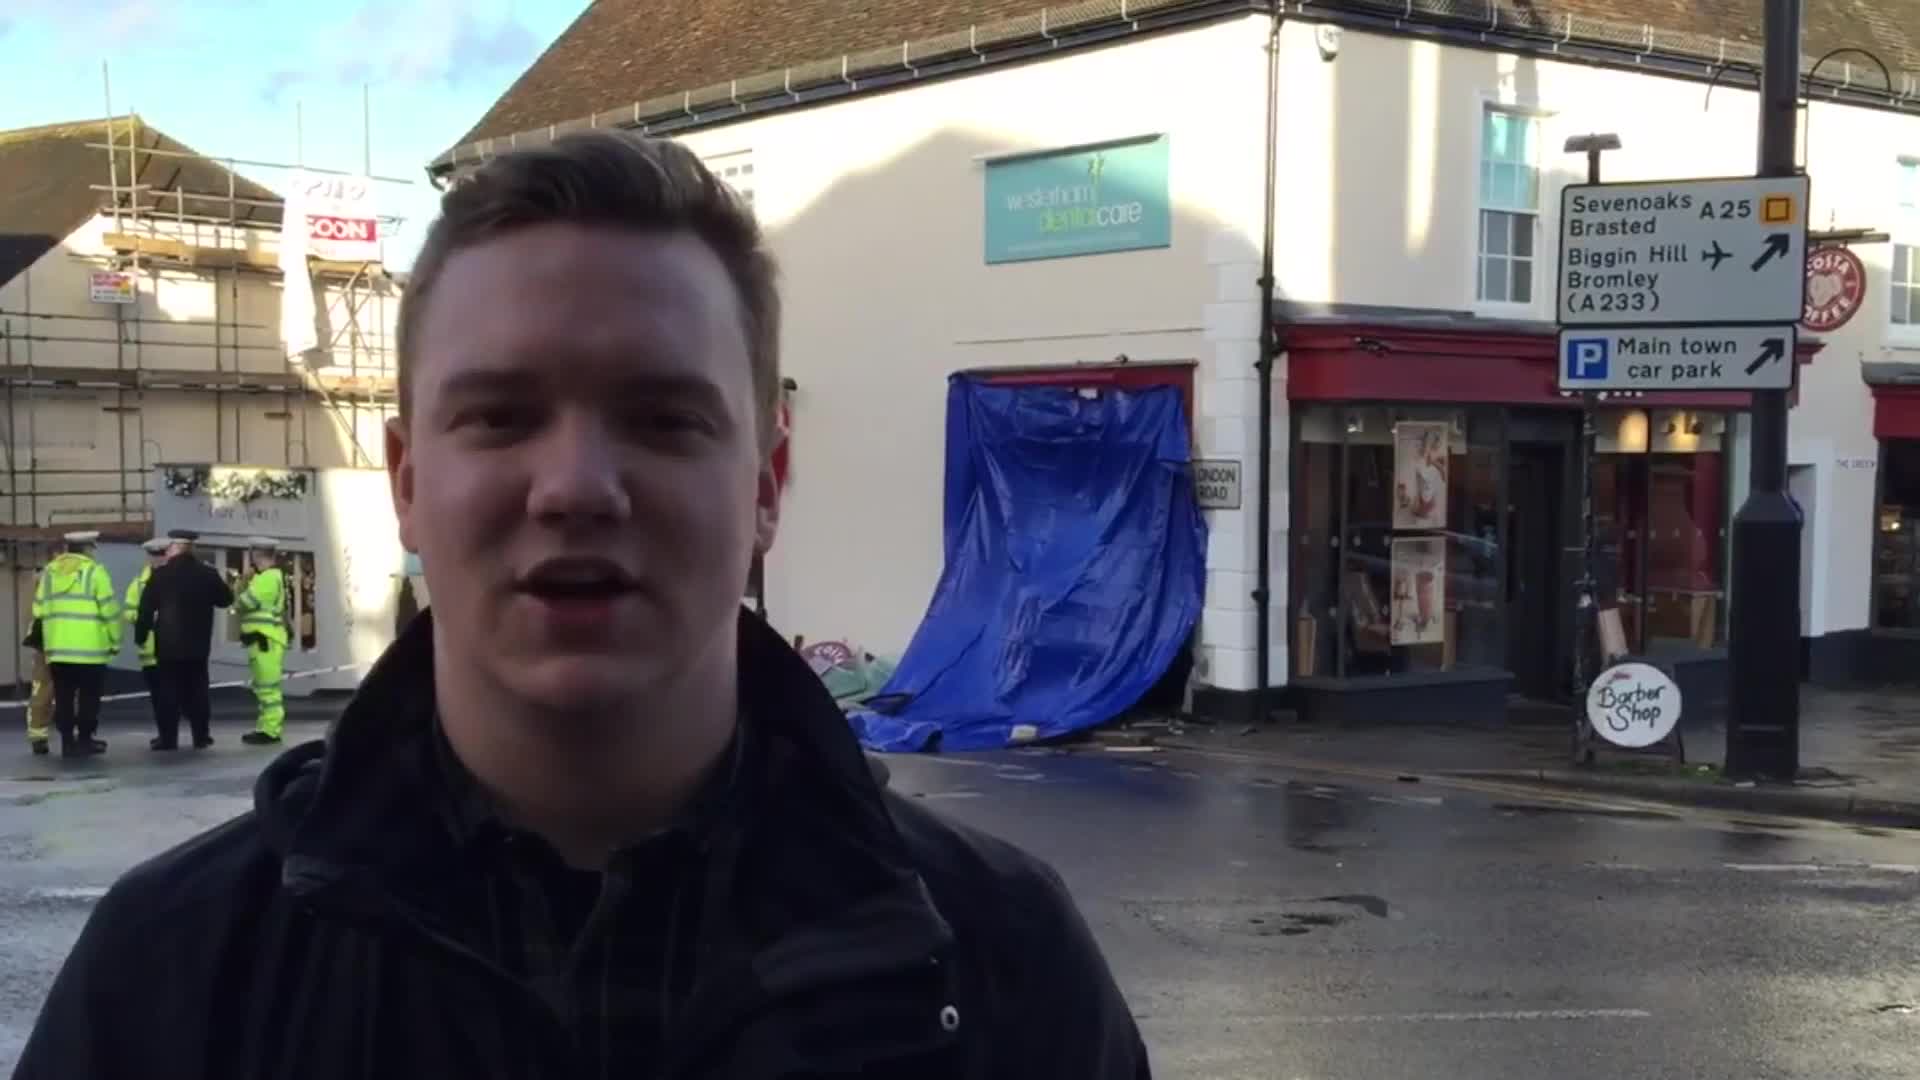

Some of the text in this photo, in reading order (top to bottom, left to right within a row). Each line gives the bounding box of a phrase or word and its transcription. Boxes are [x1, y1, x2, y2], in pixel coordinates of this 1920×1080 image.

[1572, 191, 1752, 219] Sevenoaks A25
[1569, 216, 1657, 237] Brasted
[1567, 243, 1688, 268] Biggin Hill
[1567, 270, 1659, 290] Bromley
[1567, 290, 1660, 313] (A233)
[1617, 336, 1737, 355] Main town
[1627, 360, 1722, 381] car park
[1597, 681, 1666, 709] Barber
[1606, 703, 1661, 732] Shop
